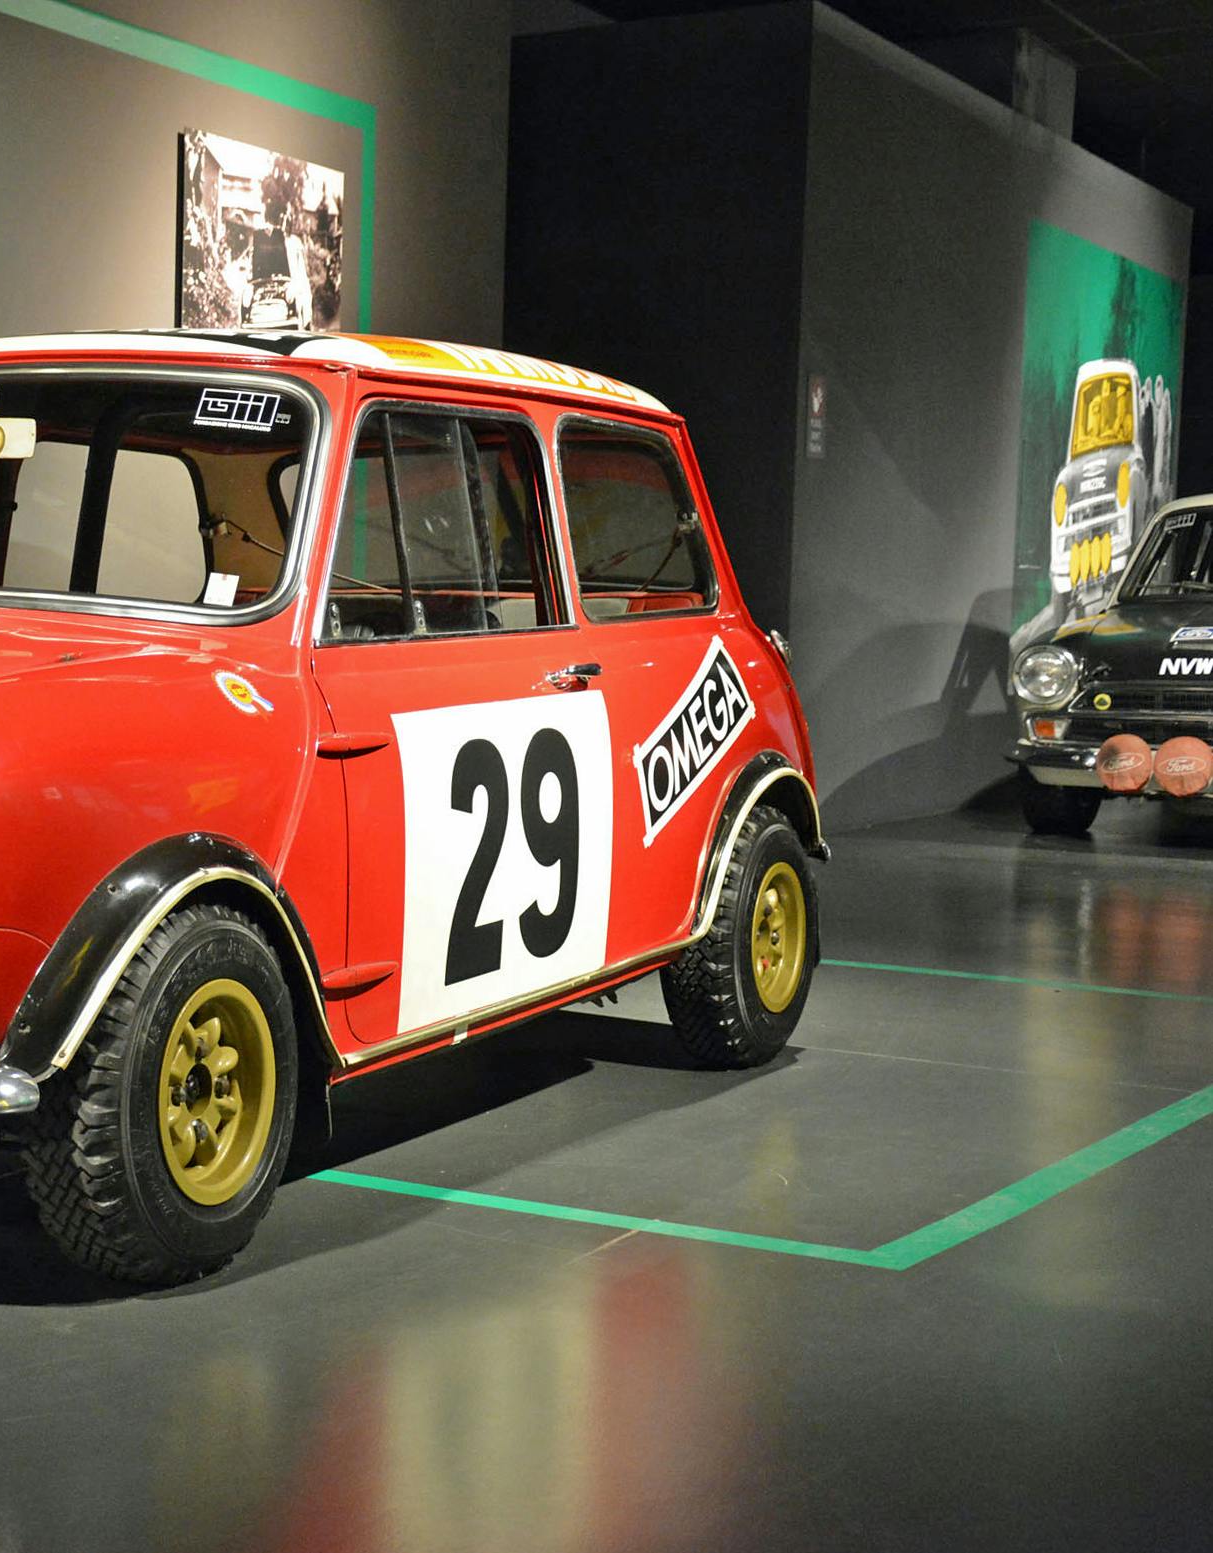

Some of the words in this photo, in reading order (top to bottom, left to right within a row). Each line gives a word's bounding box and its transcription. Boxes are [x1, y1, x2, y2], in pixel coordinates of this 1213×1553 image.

[646, 661, 746, 813] OMEGA
[1166, 758, 1197, 772] Ford
[444, 727, 580, 987] 29
